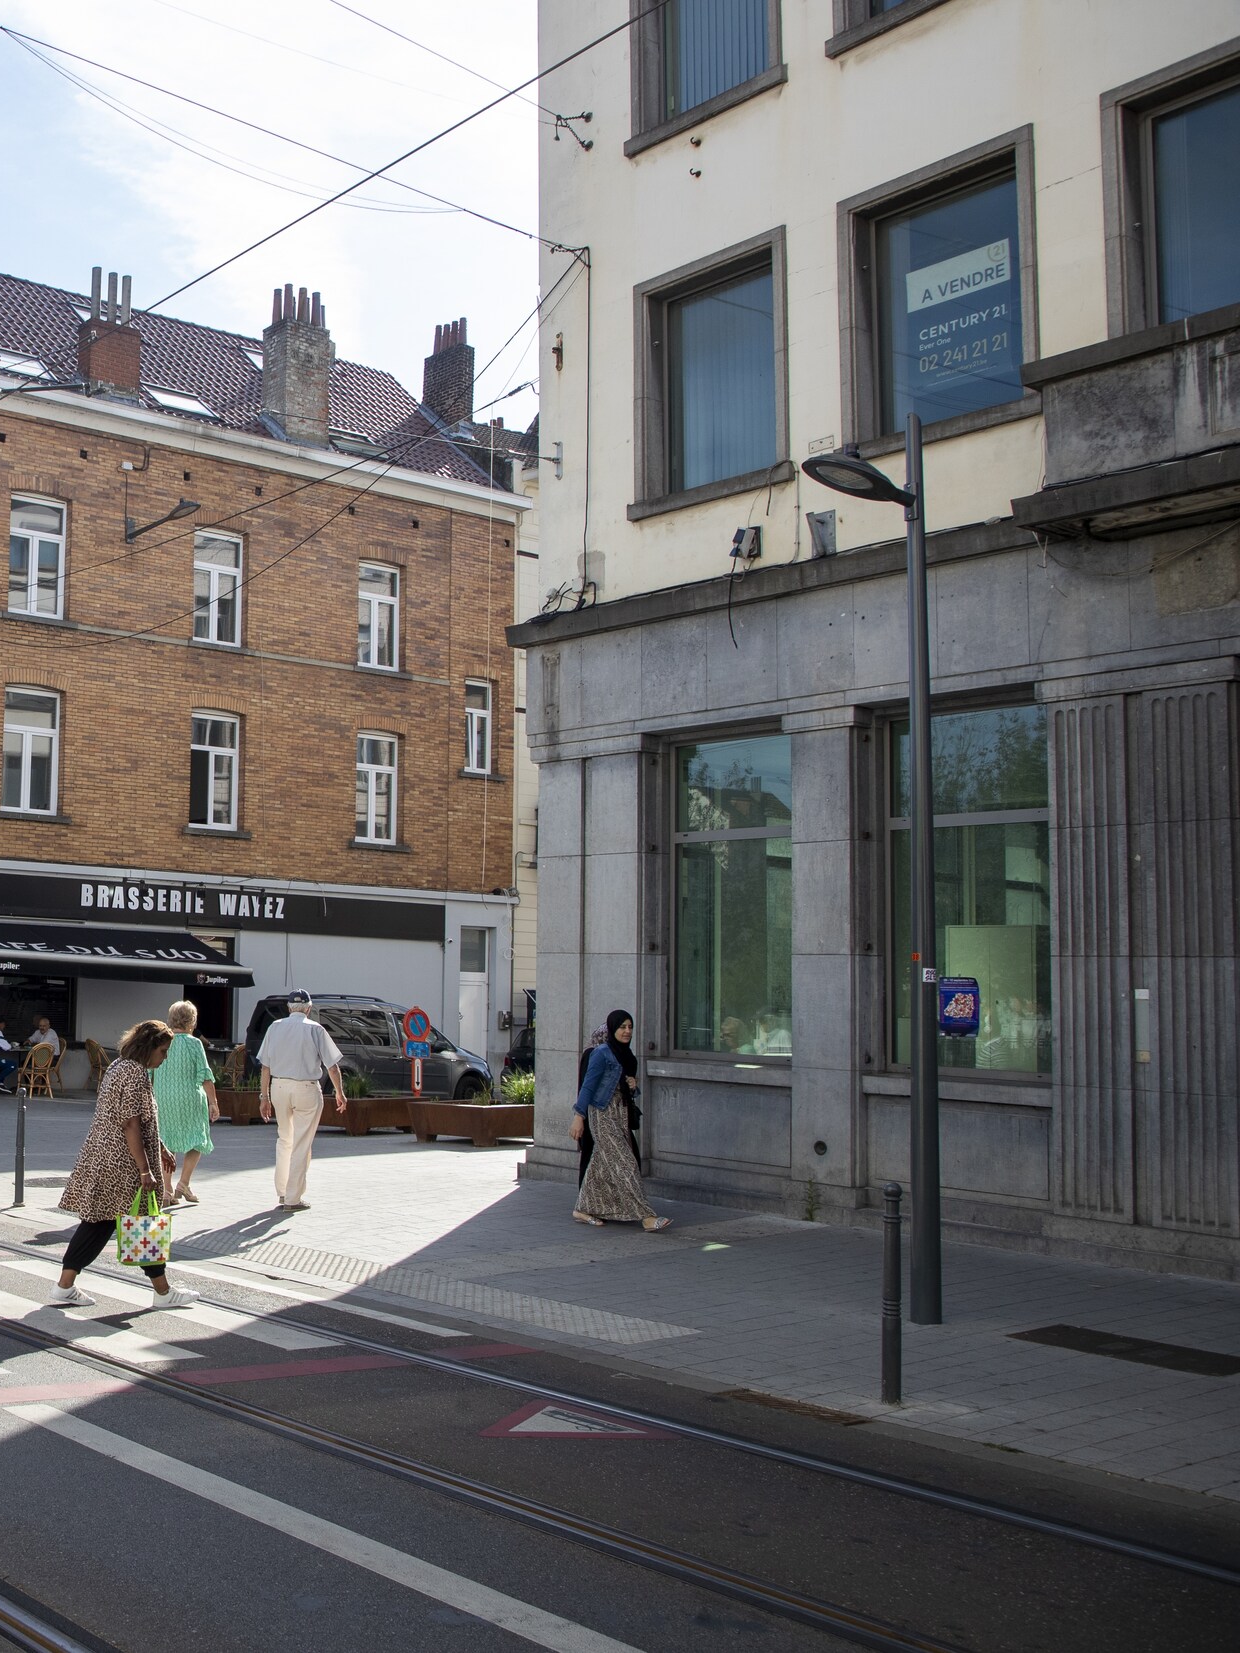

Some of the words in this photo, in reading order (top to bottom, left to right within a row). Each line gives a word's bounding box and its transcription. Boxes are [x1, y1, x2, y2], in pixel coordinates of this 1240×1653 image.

[921, 288, 933, 304] A
[937, 262, 1005, 297] VENDRE
[919, 309, 990, 340] CENTURY
[919, 342, 935, 352] Ever
[936, 337, 951, 346] One
[919, 353, 939, 373] 02
[942, 344, 968, 367] 241
[972, 338, 988, 358] 21
[991, 331, 1008, 352] 21
[80, 883, 204, 914] BRASSERIE
[218, 893, 285, 919] WAYEZ
[64, 945, 123, 957] DU
[134, 948, 207, 961] SUD
[205, 975, 229, 984] Jupiler
